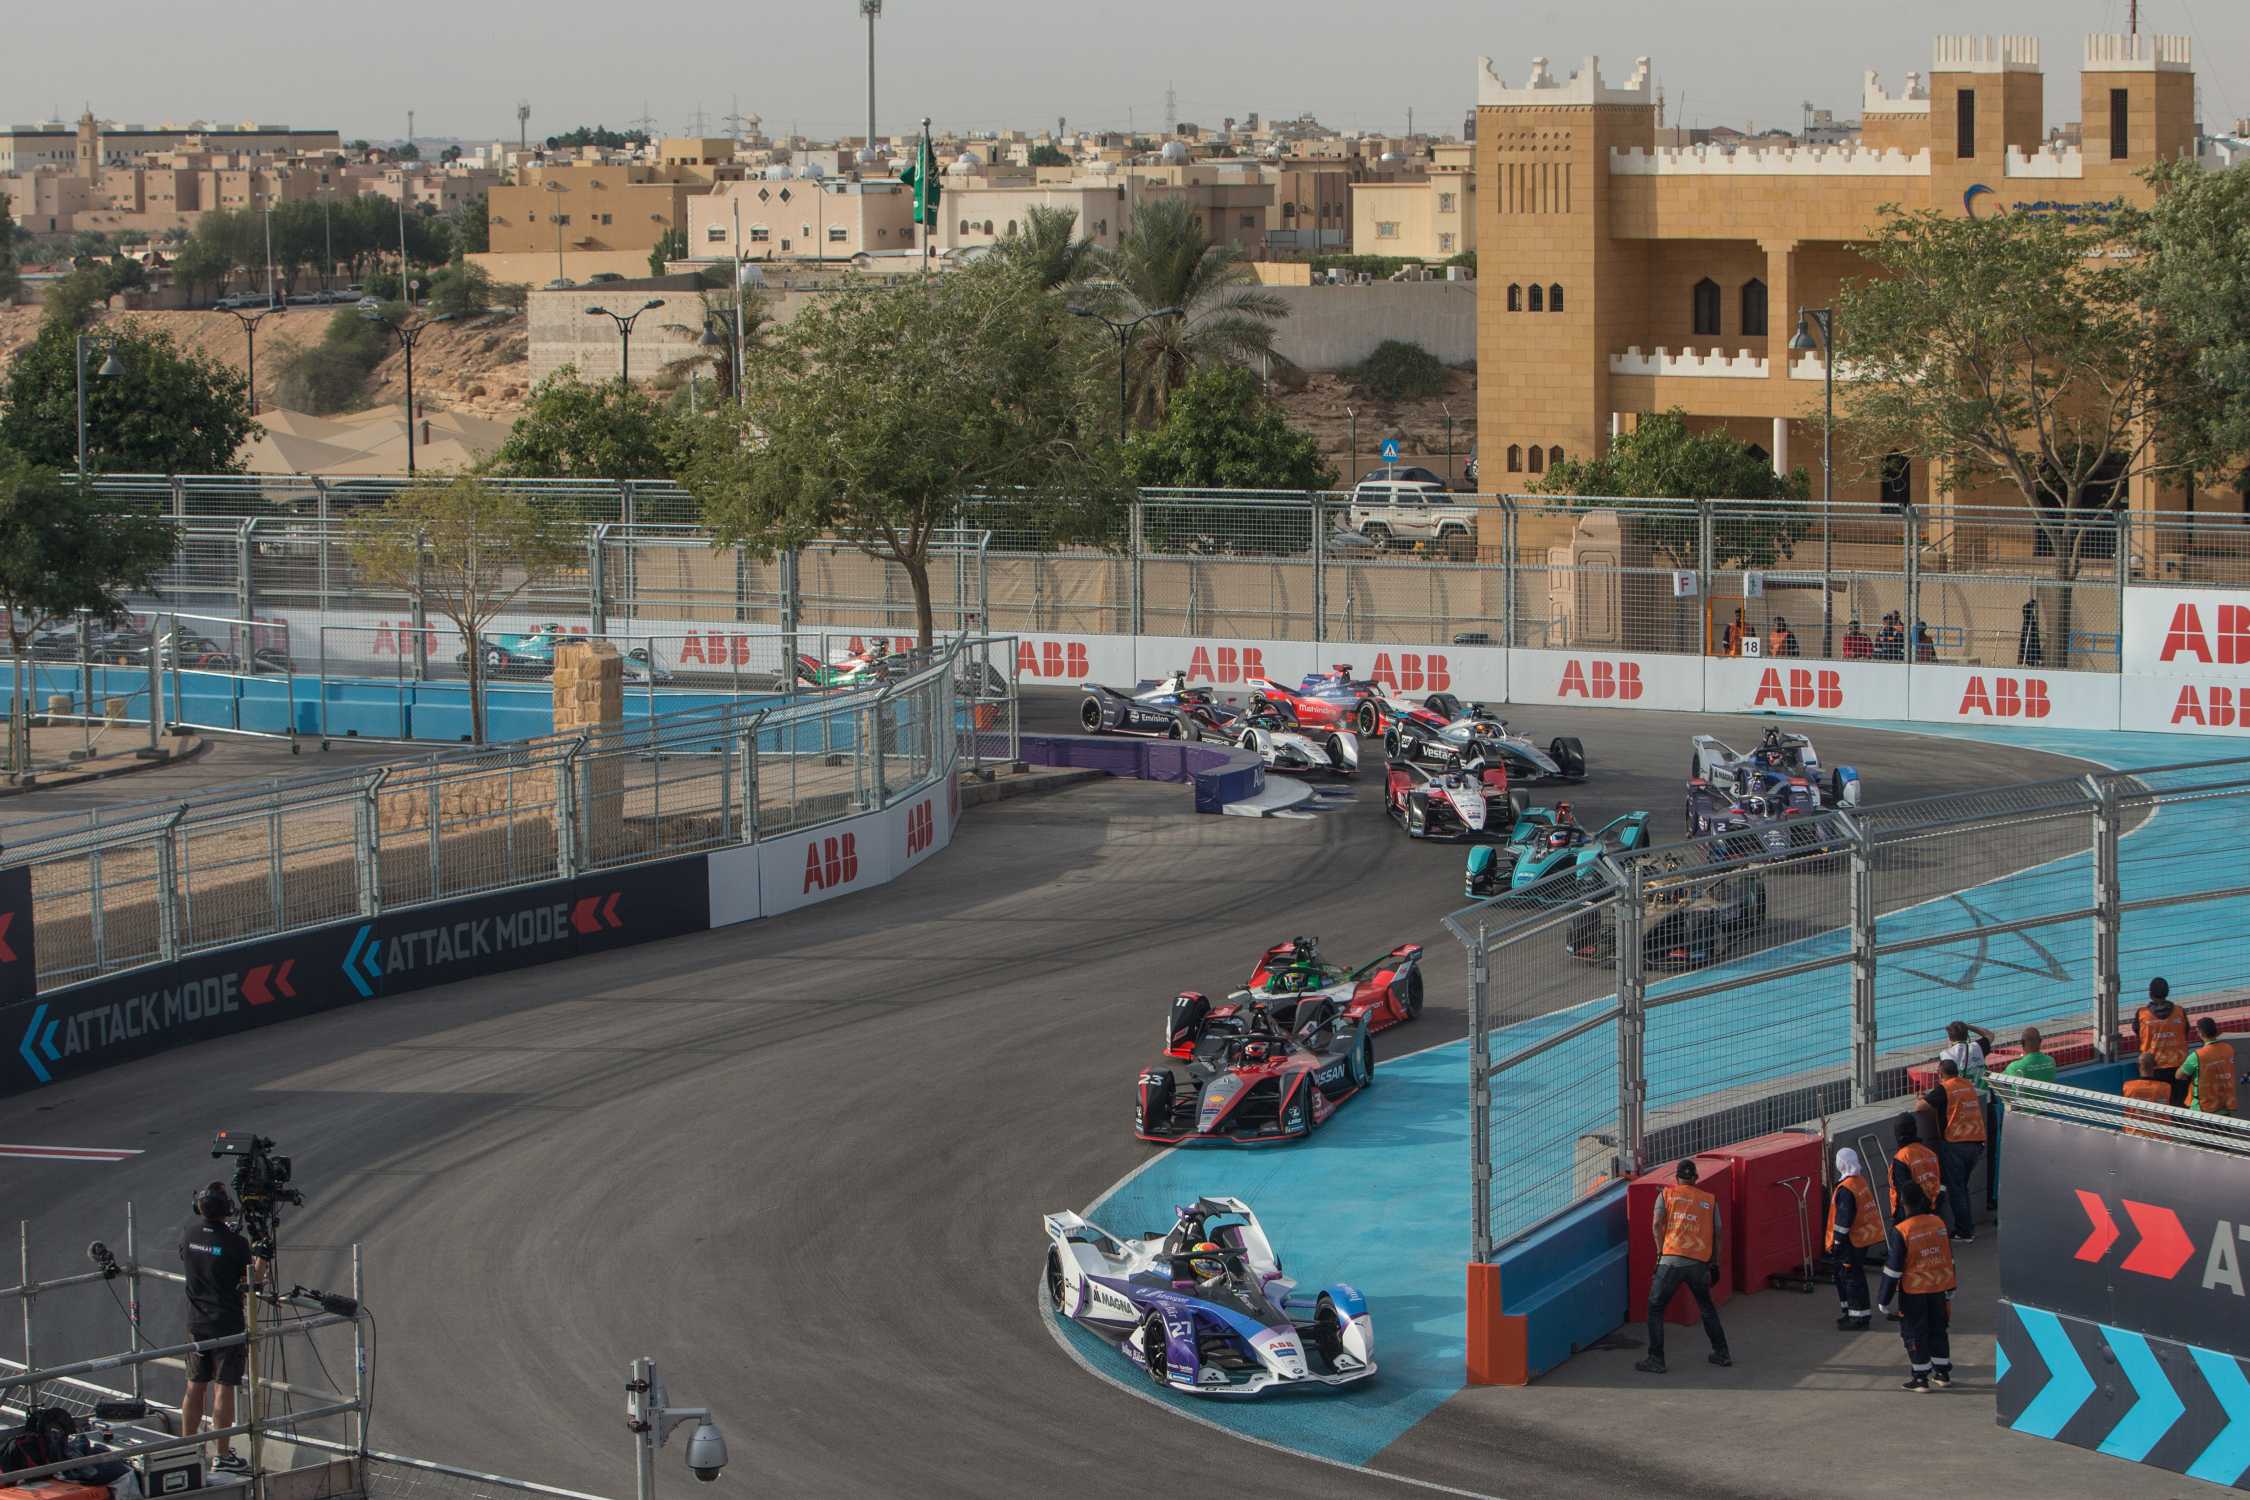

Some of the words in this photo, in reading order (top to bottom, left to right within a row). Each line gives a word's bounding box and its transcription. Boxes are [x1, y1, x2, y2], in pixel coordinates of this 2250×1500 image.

[680, 630, 750, 666] ABB
[1016, 641, 1089, 678] ABB
[1188, 646, 1266, 683] ABB
[1744, 641, 1758, 653] 18
[1371, 653, 1450, 691] ABB
[1558, 659, 1643, 700] ABB
[1754, 668, 1843, 709] ABB
[1959, 676, 2051, 718] ABB
[1141, 713, 1169, 723] Envision
[907, 799, 934, 858] ABB
[1717, 823, 1726, 832] 2
[803, 832, 858, 894] ABB
[387, 917, 490, 975] ATTACK
[496, 903, 569, 950] MODE
[64, 992, 160, 1056] ATTACK
[164, 972, 240, 1028] MODE
[1176, 998, 1189, 1007] 11
[1138, 1074, 1164, 1086] 23
[1101, 1291, 1134, 1316] MAGNA
[1169, 1321, 1192, 1338] 27
